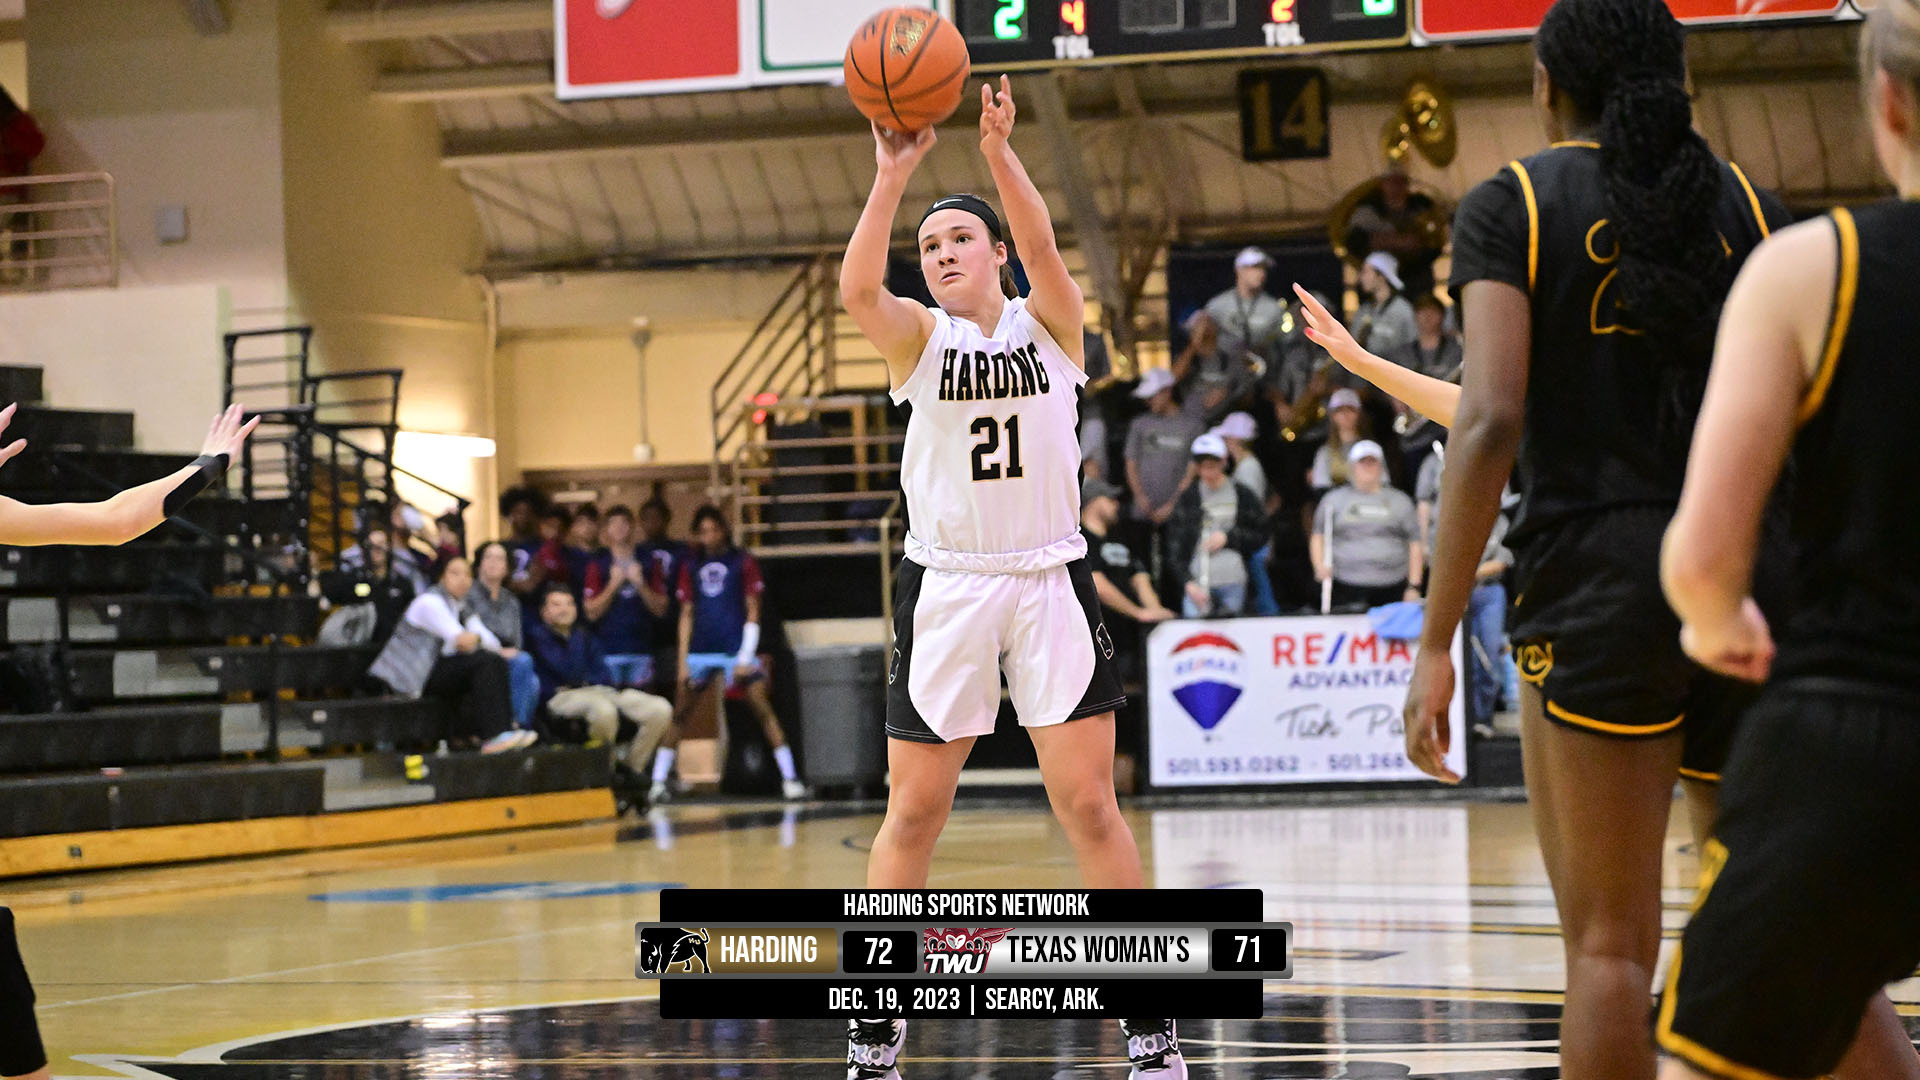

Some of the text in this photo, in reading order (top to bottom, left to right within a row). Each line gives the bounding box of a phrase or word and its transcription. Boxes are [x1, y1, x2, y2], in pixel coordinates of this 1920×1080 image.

[1061, 0, 1085, 35] 4
[1250, 77, 1326, 152] 14
[938, 341, 1051, 402] HARDING
[969, 413, 1025, 483] 21
[1272, 632, 1412, 667] RE/MA
[1287, 668, 1413, 690] ADVANTAG
